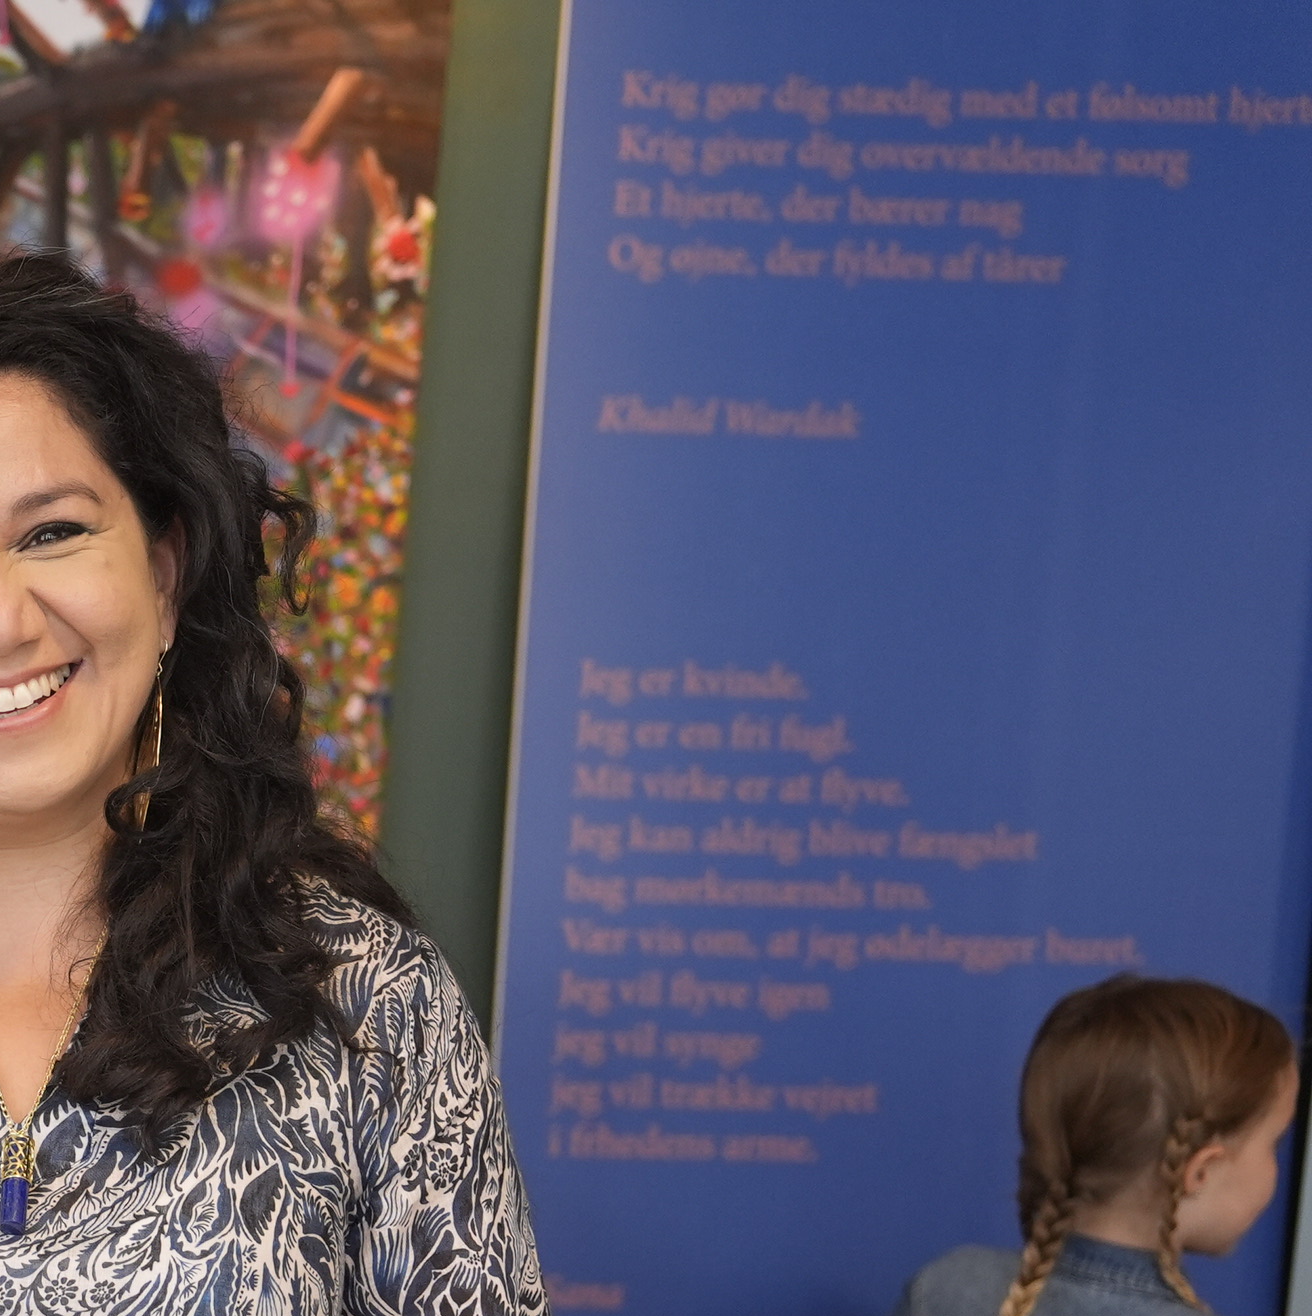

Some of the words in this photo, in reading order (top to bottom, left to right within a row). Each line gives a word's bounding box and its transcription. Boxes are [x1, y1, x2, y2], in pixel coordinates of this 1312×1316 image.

[621, 71, 698, 120] Krig
[773, 74, 830, 124] dig
[959, 78, 1039, 119] med
[1045, 89, 1078, 119] et
[1227, 85, 1312, 134] hjert
[618, 126, 694, 173] Krig
[700, 130, 790, 176] giver
[797, 130, 854, 180] dig
[1114, 147, 1191, 189] sorg
[614, 181, 652, 216] Et
[781, 184, 842, 222] der
[959, 200, 1023, 239] nag
[608, 234, 663, 283] Og
[765, 237, 827, 277] der
[833, 238, 934, 287] fyldes
[942, 242, 981, 282] af
[579, 658, 632, 706] Jeg
[638, 666, 677, 697] er
[576, 712, 629, 758] Jeg
[635, 719, 672, 750] er
[678, 721, 722, 751] en
[731, 712, 773, 751] fri
[572, 764, 633, 801] Mit
[642, 765, 729, 803] virke
[735, 774, 775, 804] er
[779, 773, 812, 804] at
[568, 814, 622, 861] Jeg
[628, 814, 693, 852] kan
[701, 819, 802, 867] aldrig
[808, 819, 891, 858] blive
[564, 867, 626, 912] bag
[638, 922, 684, 955] vis
[767, 928, 800, 957] at
[806, 924, 858, 969] jeg
[619, 972, 663, 1007] vil
[671, 973, 749, 1015] flyve
[759, 977, 830, 1020] igen
[613, 1022, 657, 1057] vil
[664, 1033, 764, 1069] synge
[610, 1075, 654, 1108] vil
[784, 1082, 881, 1120] vejret
[570, 1127, 715, 1160] frihedens
